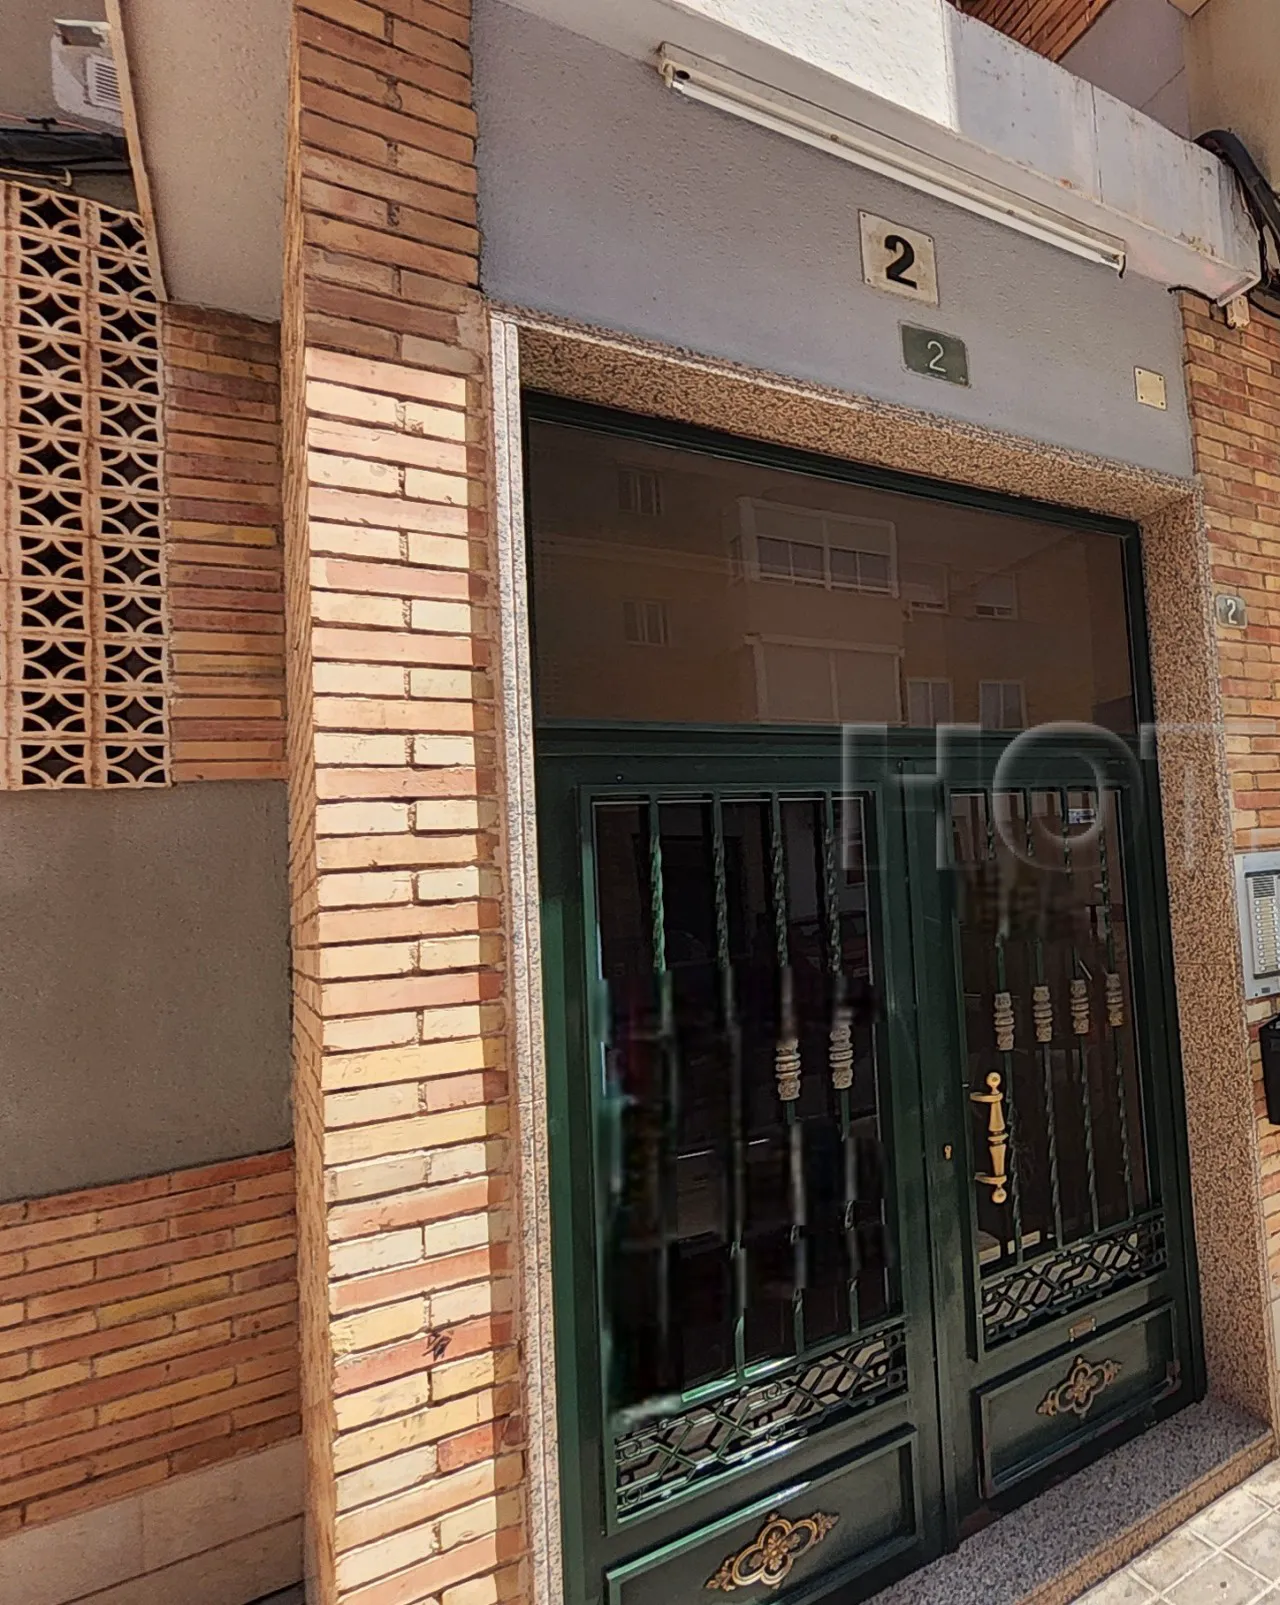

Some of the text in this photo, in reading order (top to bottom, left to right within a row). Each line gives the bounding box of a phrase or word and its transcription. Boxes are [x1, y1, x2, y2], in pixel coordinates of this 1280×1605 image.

[884, 234, 918, 290] 2
[927, 340, 947, 373] 2
[1226, 599, 1238, 625] 2
